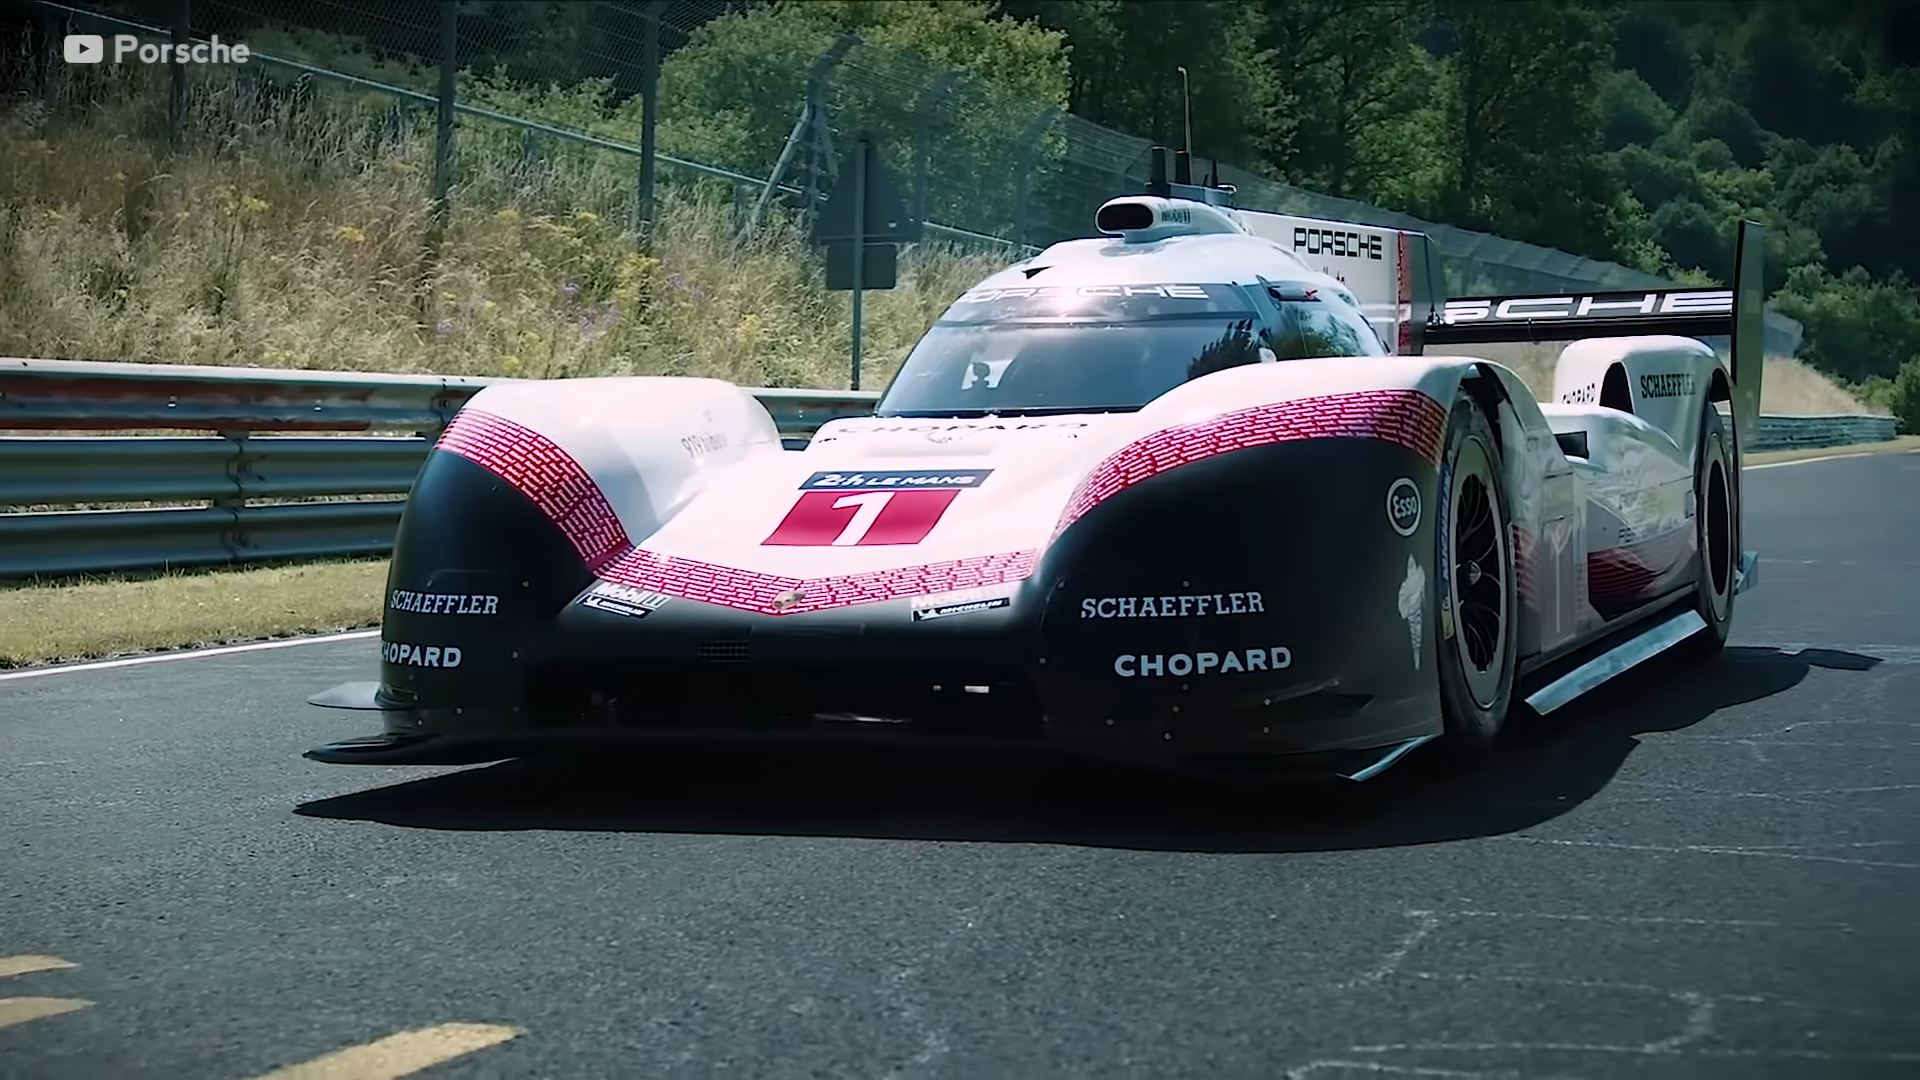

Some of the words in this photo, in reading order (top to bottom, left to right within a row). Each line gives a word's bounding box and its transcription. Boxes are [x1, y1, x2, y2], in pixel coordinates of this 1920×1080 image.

[1293, 227, 1382, 260] PORSCHE
[900, 475, 977, 486] MANS
[830, 490, 897, 546] 1
[390, 589, 499, 614] SCHAEFFLER
[1081, 591, 1265, 619] SCHAEFFLER
[1114, 646, 1292, 677] CHOPARD
